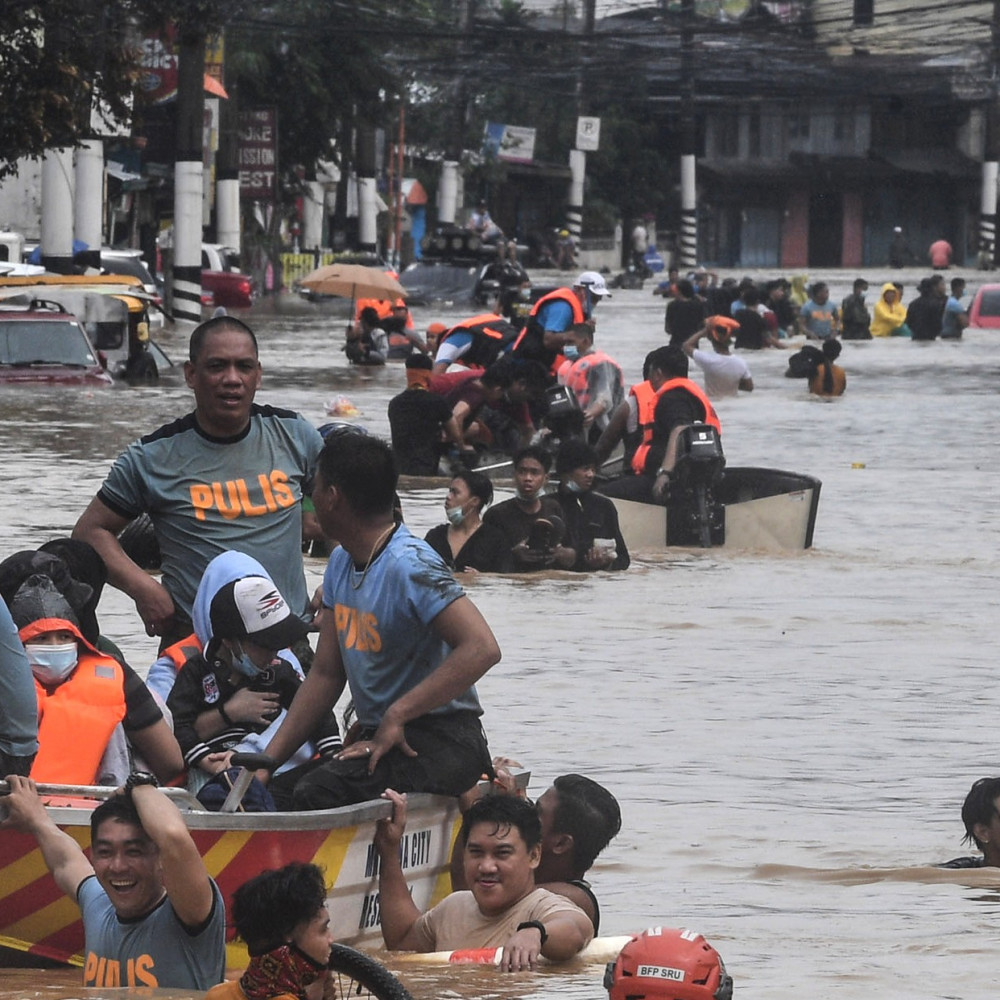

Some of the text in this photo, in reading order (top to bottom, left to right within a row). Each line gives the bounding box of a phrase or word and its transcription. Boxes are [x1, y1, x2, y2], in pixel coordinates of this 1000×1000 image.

[238, 171, 275, 188] EST
[190, 470, 296, 520] PULIS
[411, 829, 431, 867] CITY
[641, 966, 681, 979] BFP SRU
